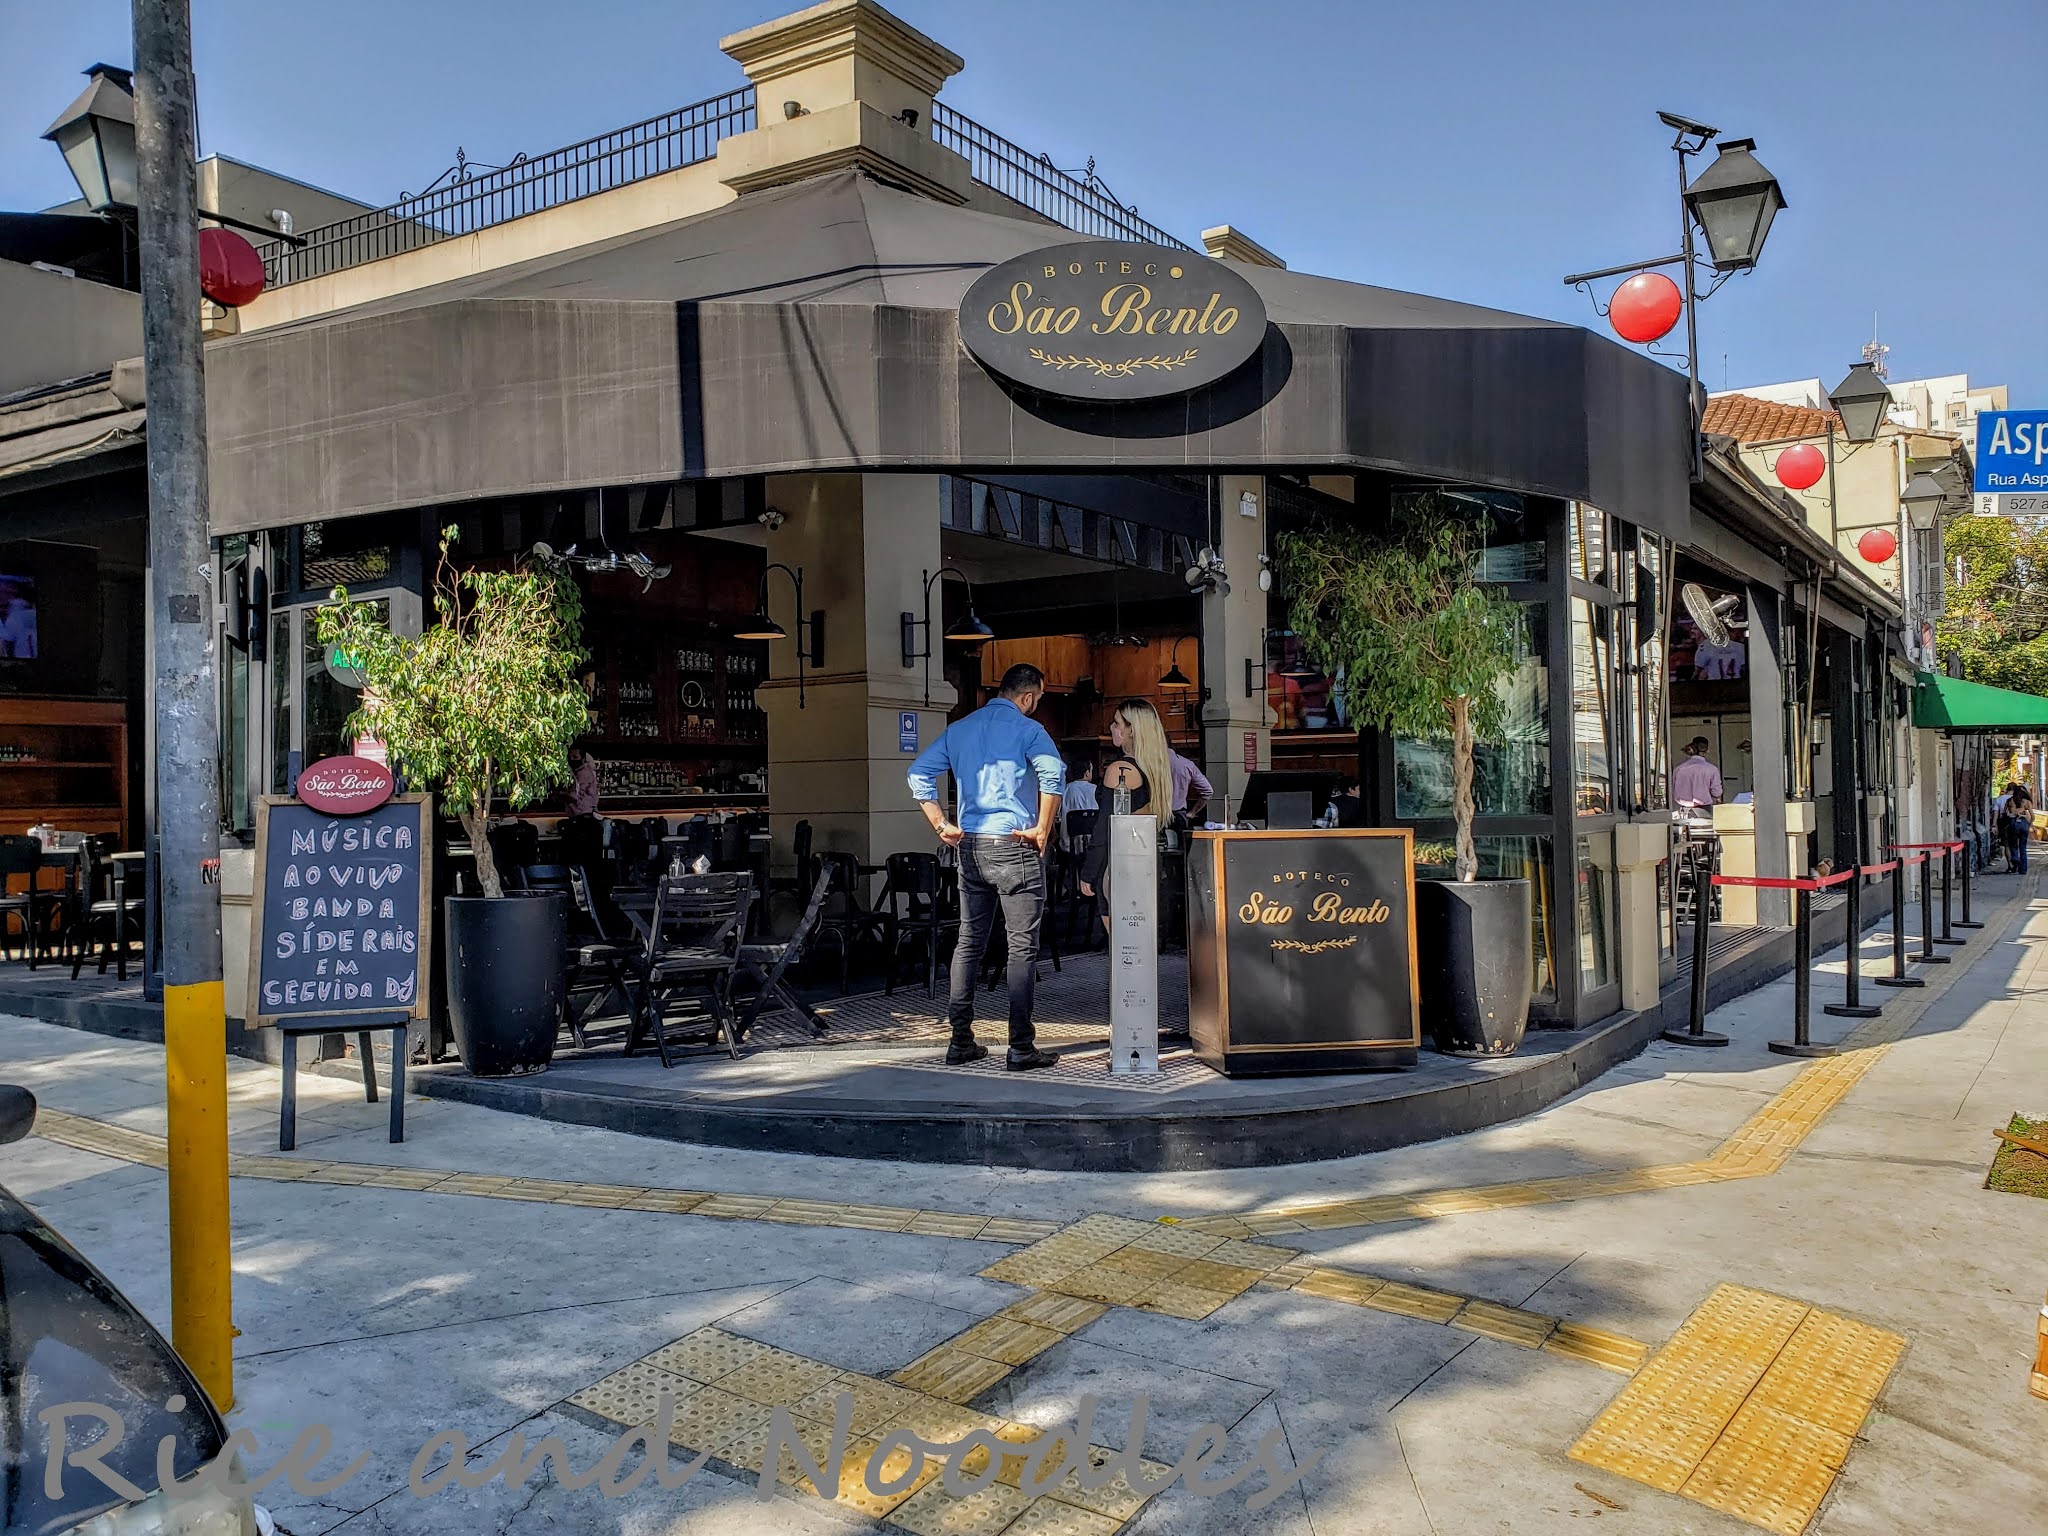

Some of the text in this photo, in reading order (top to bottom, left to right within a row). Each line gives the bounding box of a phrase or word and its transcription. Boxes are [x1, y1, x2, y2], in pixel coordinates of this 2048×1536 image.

[1043, 261, 1184, 279] BOTECO
[987, 281, 1239, 336] São Bento
[1988, 473, 2017, 486] Rua
[1982, 503, 1991, 515] 5
[2010, 498, 2037, 510] 527
[323, 768, 370, 776] BOTECO
[304, 774, 386, 791] São Bento
[291, 820, 413, 857] MÚSICA
[283, 863, 403, 891] AO VIVO
[1272, 870, 1350, 888] BOTECO
[289, 896, 394, 921] BANDA
[1239, 892, 1389, 925] São Bento
[316, 957, 360, 976] EM
[385, 969, 415, 1003] DJ
